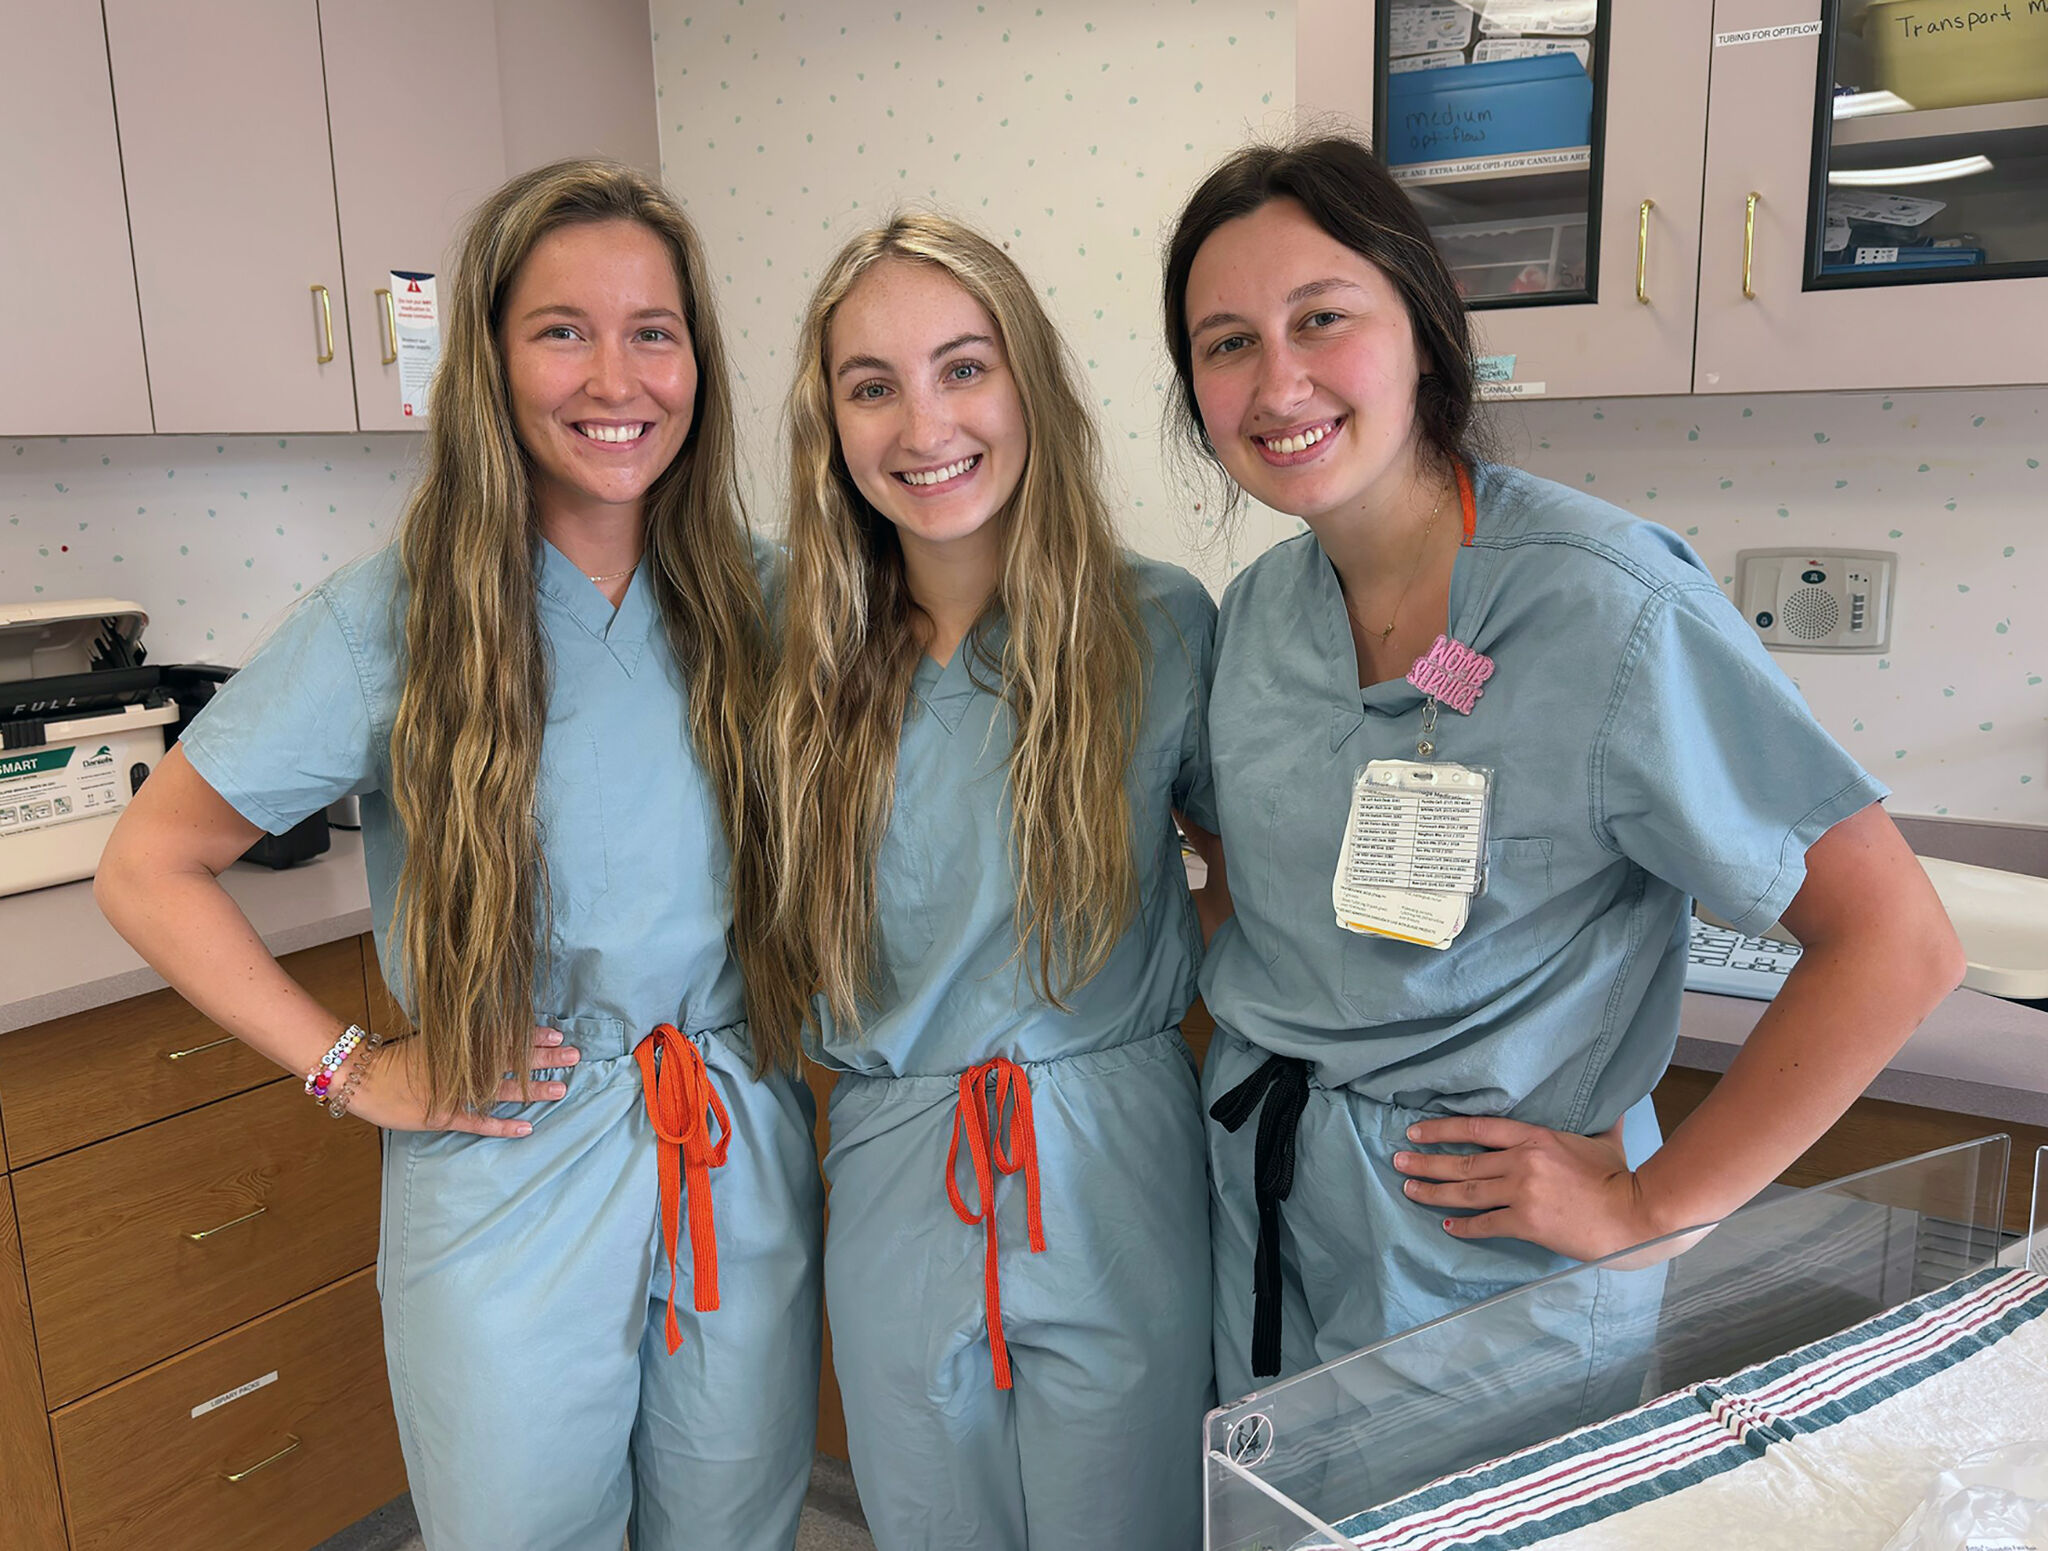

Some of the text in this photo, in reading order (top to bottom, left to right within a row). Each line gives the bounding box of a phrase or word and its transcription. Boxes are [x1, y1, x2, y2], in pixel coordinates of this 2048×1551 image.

[1718, 23, 1819, 44] TUBING FOR OPTIFLOW
[1895, 4, 2012, 37] Transport
[1405, 102, 1493, 130] medium
[1410, 169, 1427, 177] AND
[1429, 163, 1482, 176] EXTRA-LARGE
[1482, 157, 1526, 170] OPTI-FLOW
[1526, 154, 1569, 166] CANNULAS
[1569, 152, 1587, 162] ARE
[1427, 635, 1495, 686] WOMB
[1407, 660, 1484, 714] SERVICE
[12, 697, 77, 715] FULL
[210, 1380, 260, 1407] LIBRARY PACKS
